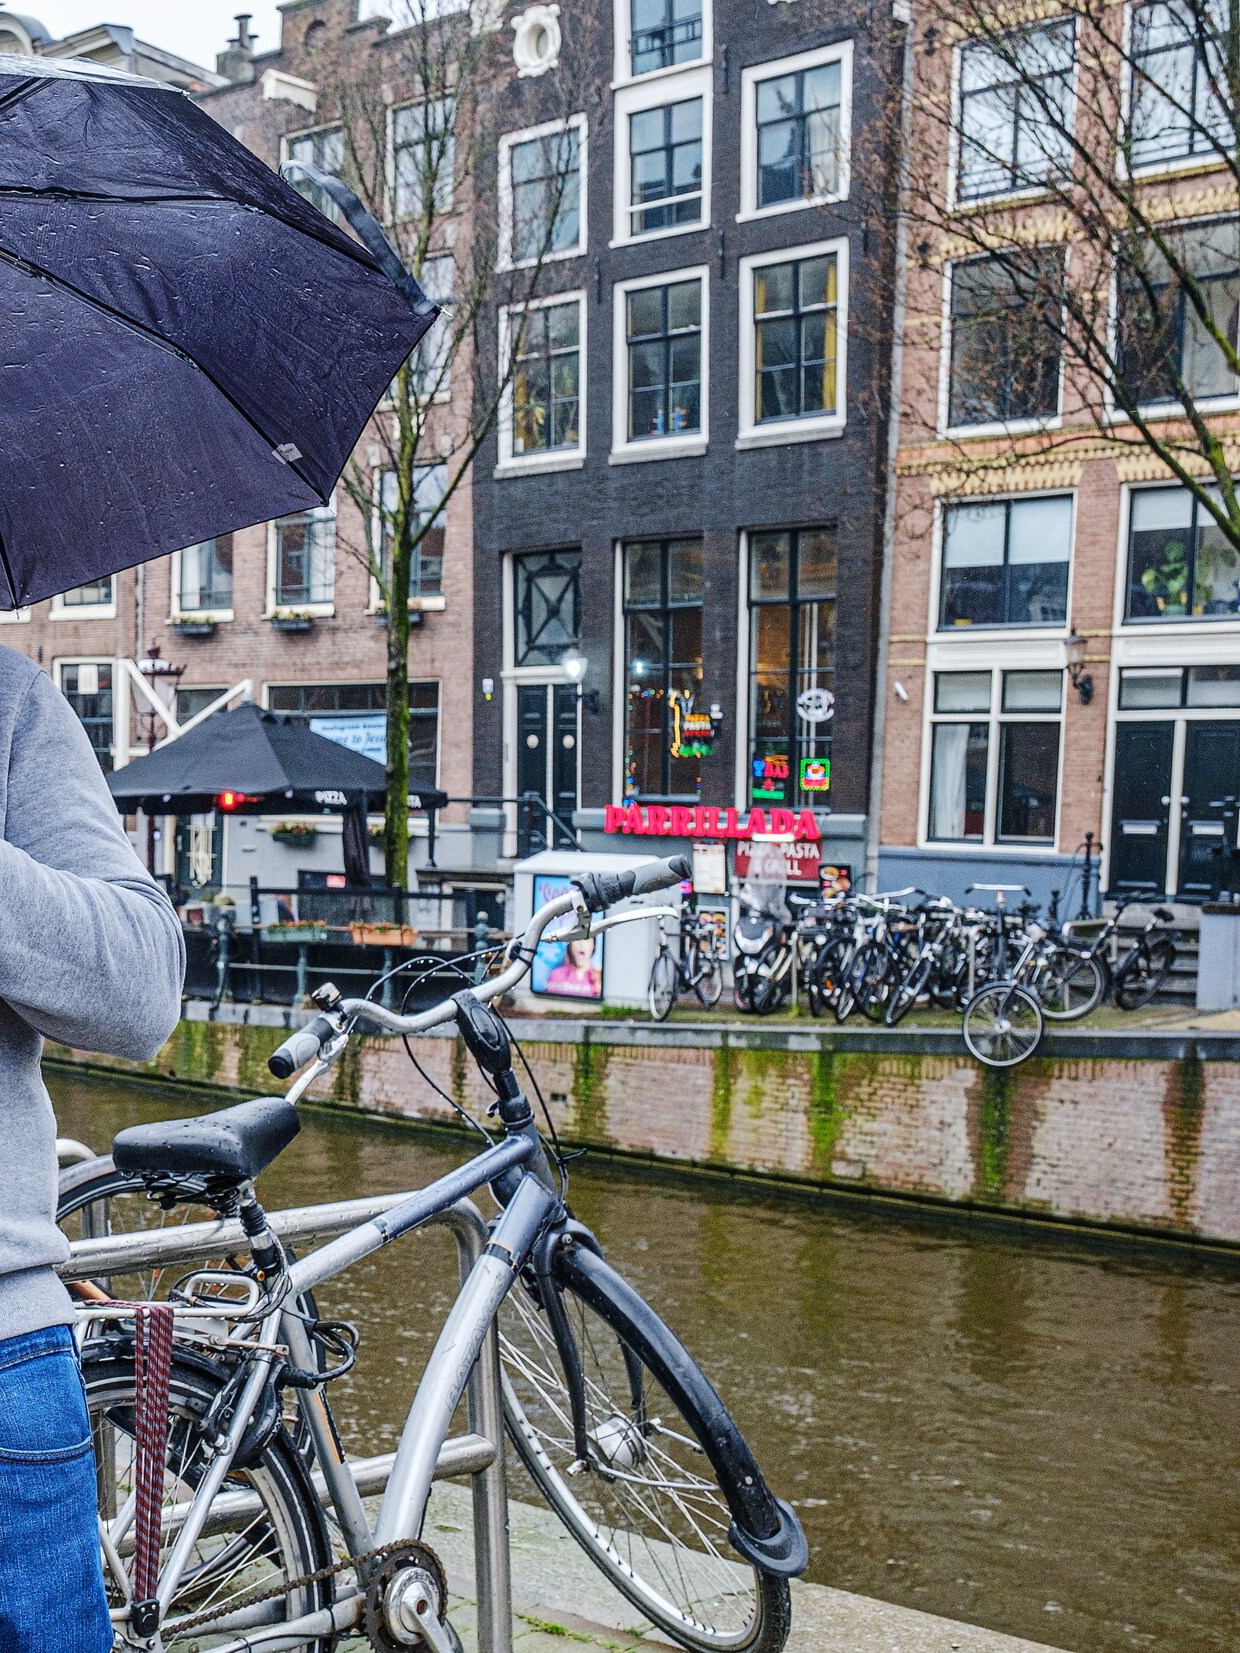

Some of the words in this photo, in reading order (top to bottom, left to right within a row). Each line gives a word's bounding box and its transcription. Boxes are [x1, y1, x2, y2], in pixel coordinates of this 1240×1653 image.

[315, 791, 348, 805] PIZZA
[603, 804, 821, 840] PARRILLADA
[780, 842, 820, 859] PASTA
[444, 1269, 506, 1413] BATAVUS
